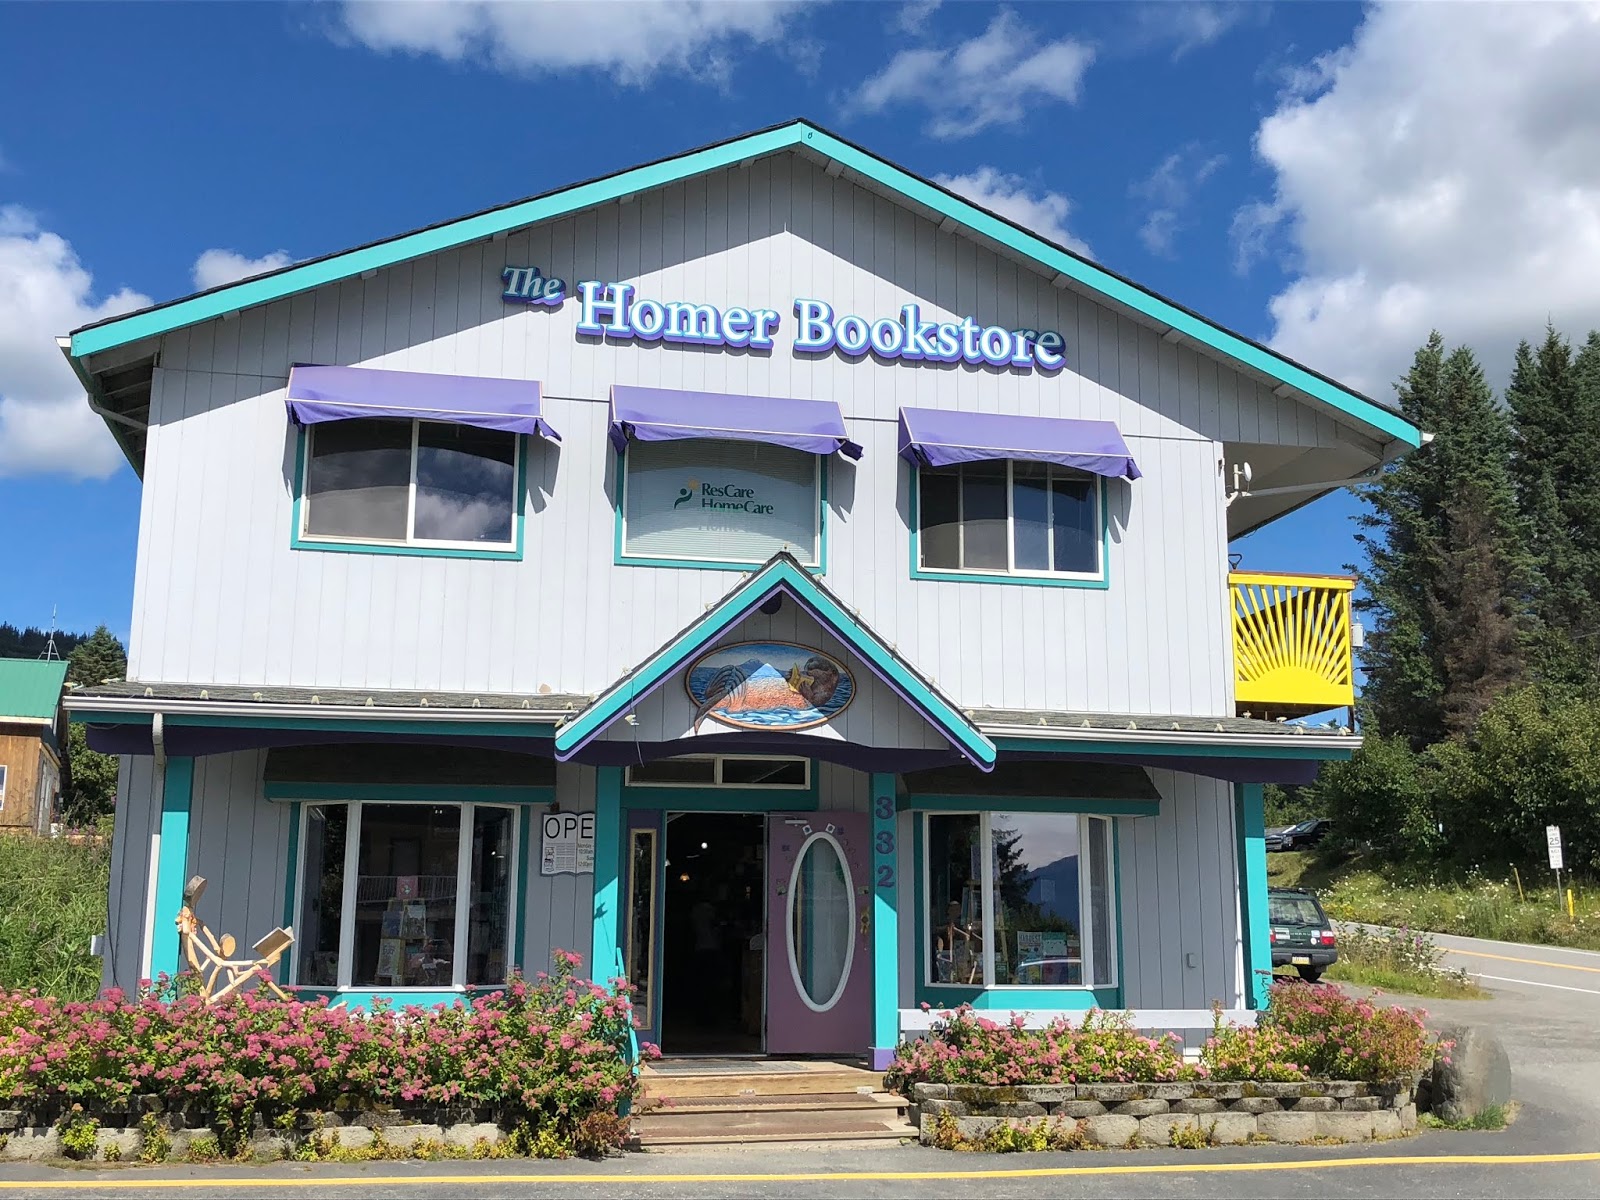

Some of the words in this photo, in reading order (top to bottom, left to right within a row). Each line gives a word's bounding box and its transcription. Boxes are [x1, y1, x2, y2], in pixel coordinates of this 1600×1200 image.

[502, 266, 565, 305] The
[577, 280, 778, 349] Homer
[794, 298, 1066, 370] Bookstore
[702, 483, 754, 498] ResCare
[545, 817, 593, 838] OPE
[875, 796, 895, 888] 332
[1549, 837, 1559, 845] 25
